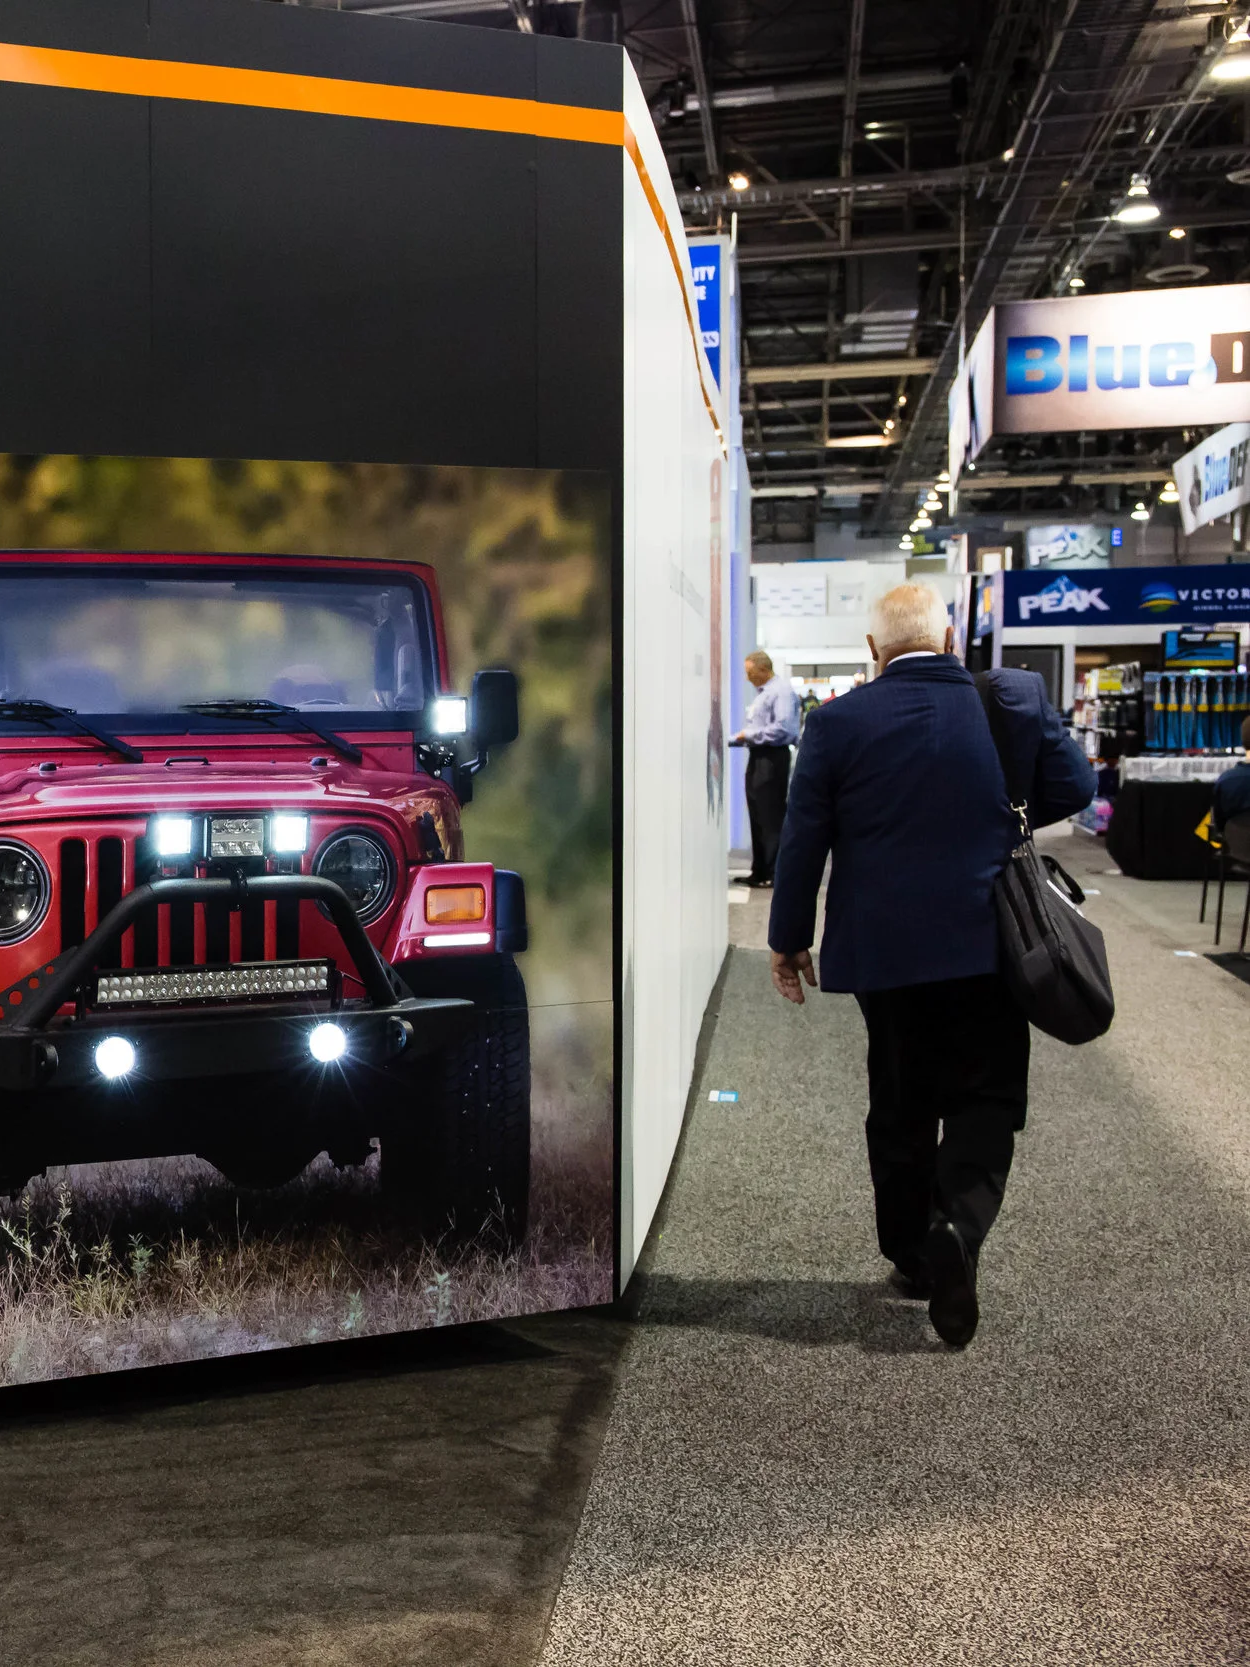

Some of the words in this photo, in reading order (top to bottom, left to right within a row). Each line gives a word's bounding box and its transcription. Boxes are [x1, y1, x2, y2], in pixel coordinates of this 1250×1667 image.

[693, 265, 716, 282] ITY
[1177, 587, 1250, 601] VICTOR
[1018, 587, 1111, 620] PEAK
